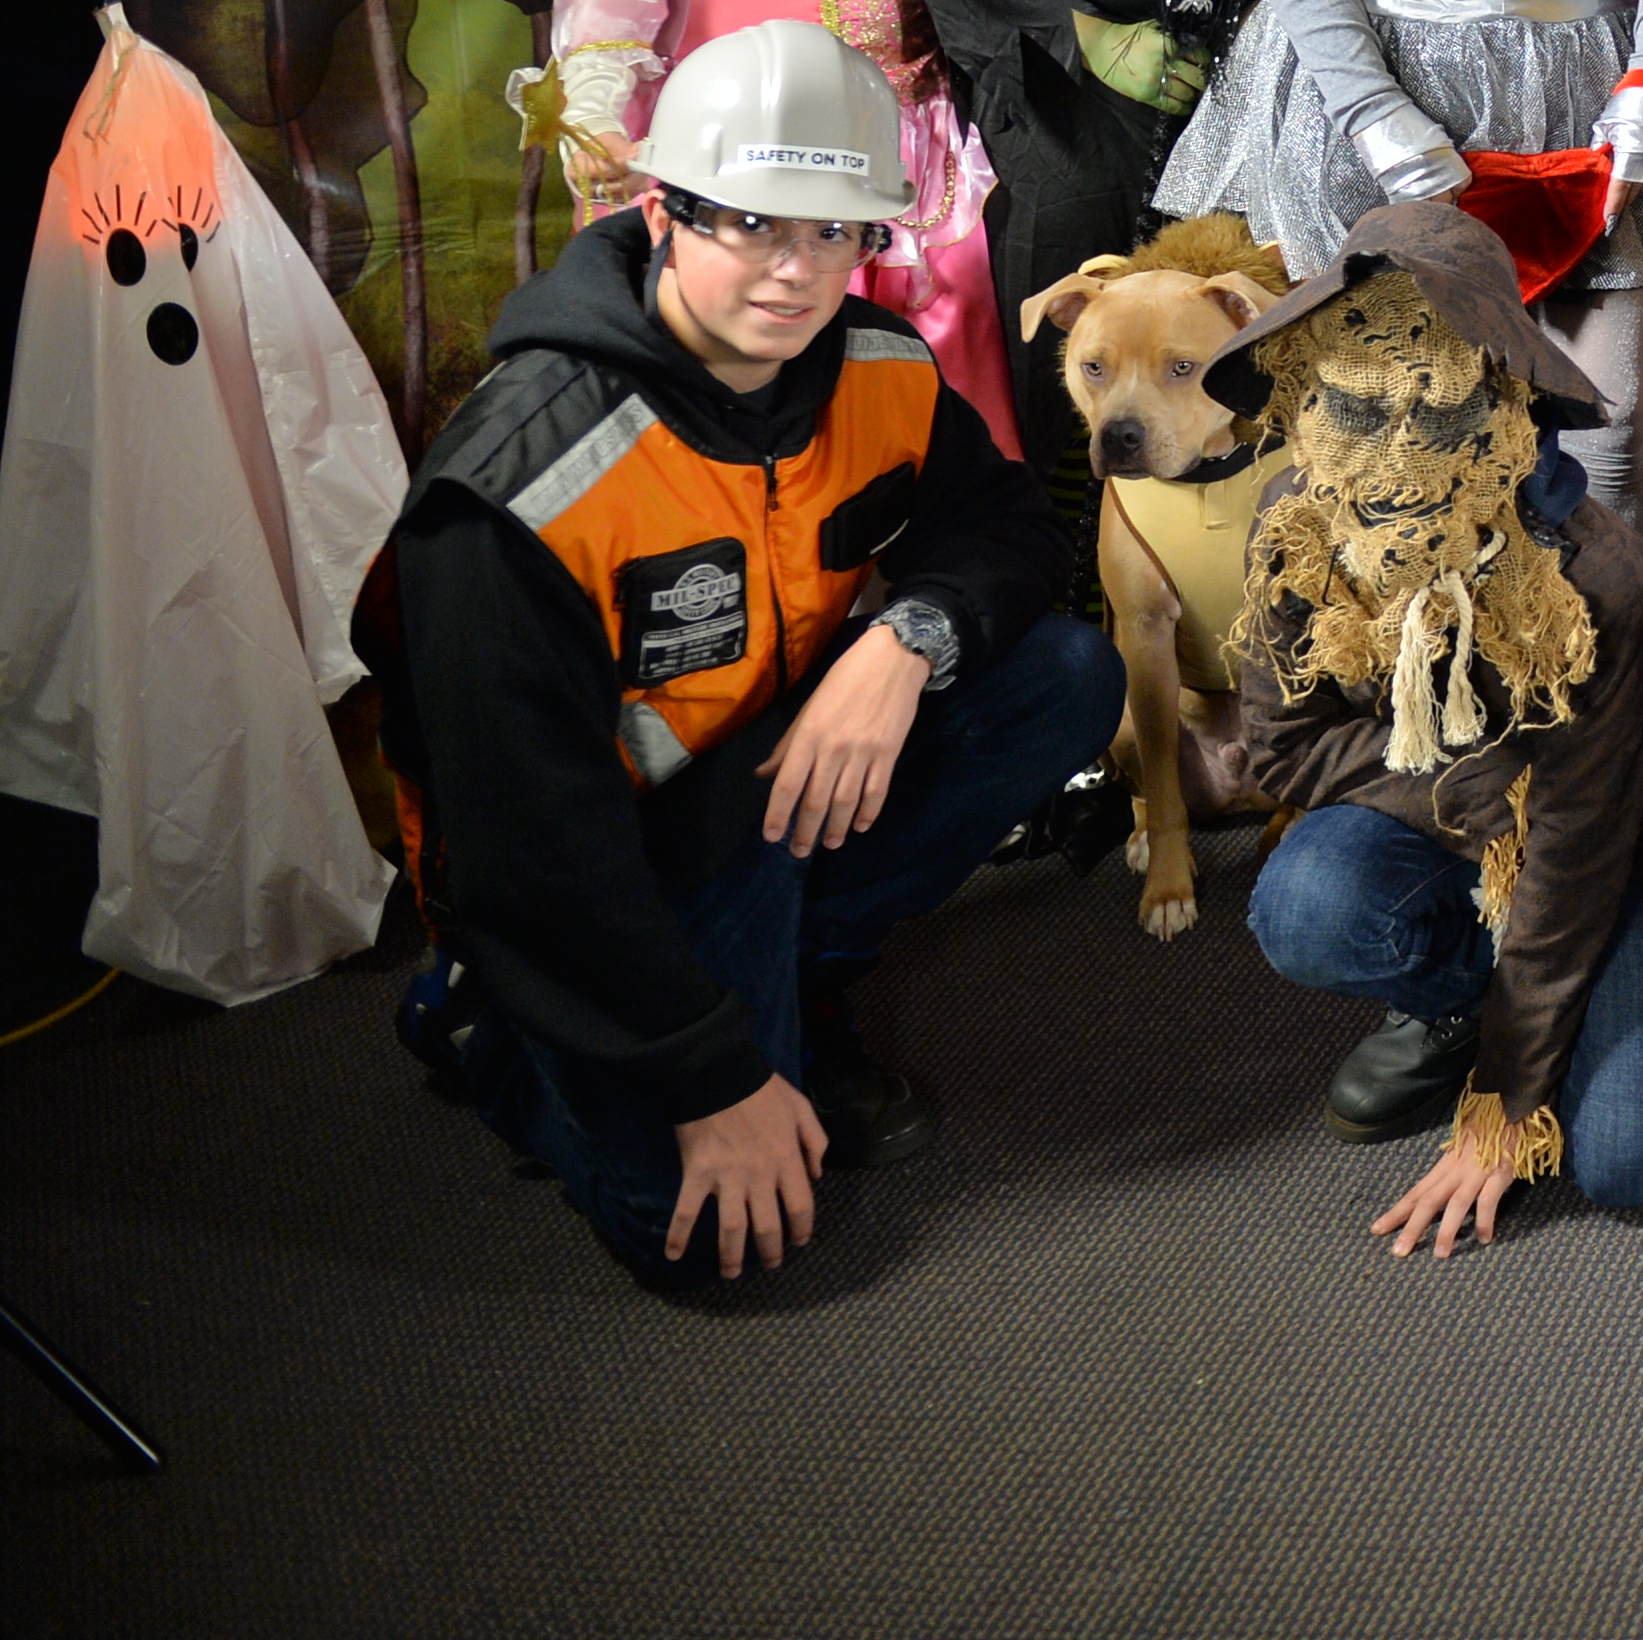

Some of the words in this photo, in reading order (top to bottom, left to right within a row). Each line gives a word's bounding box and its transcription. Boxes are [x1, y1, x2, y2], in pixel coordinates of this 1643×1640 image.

[746, 149, 806, 164] SAFETY
[811, 152, 836, 166] ON
[841, 154, 865, 170] TOP
[655, 575, 738, 608] MIL-SPEC
